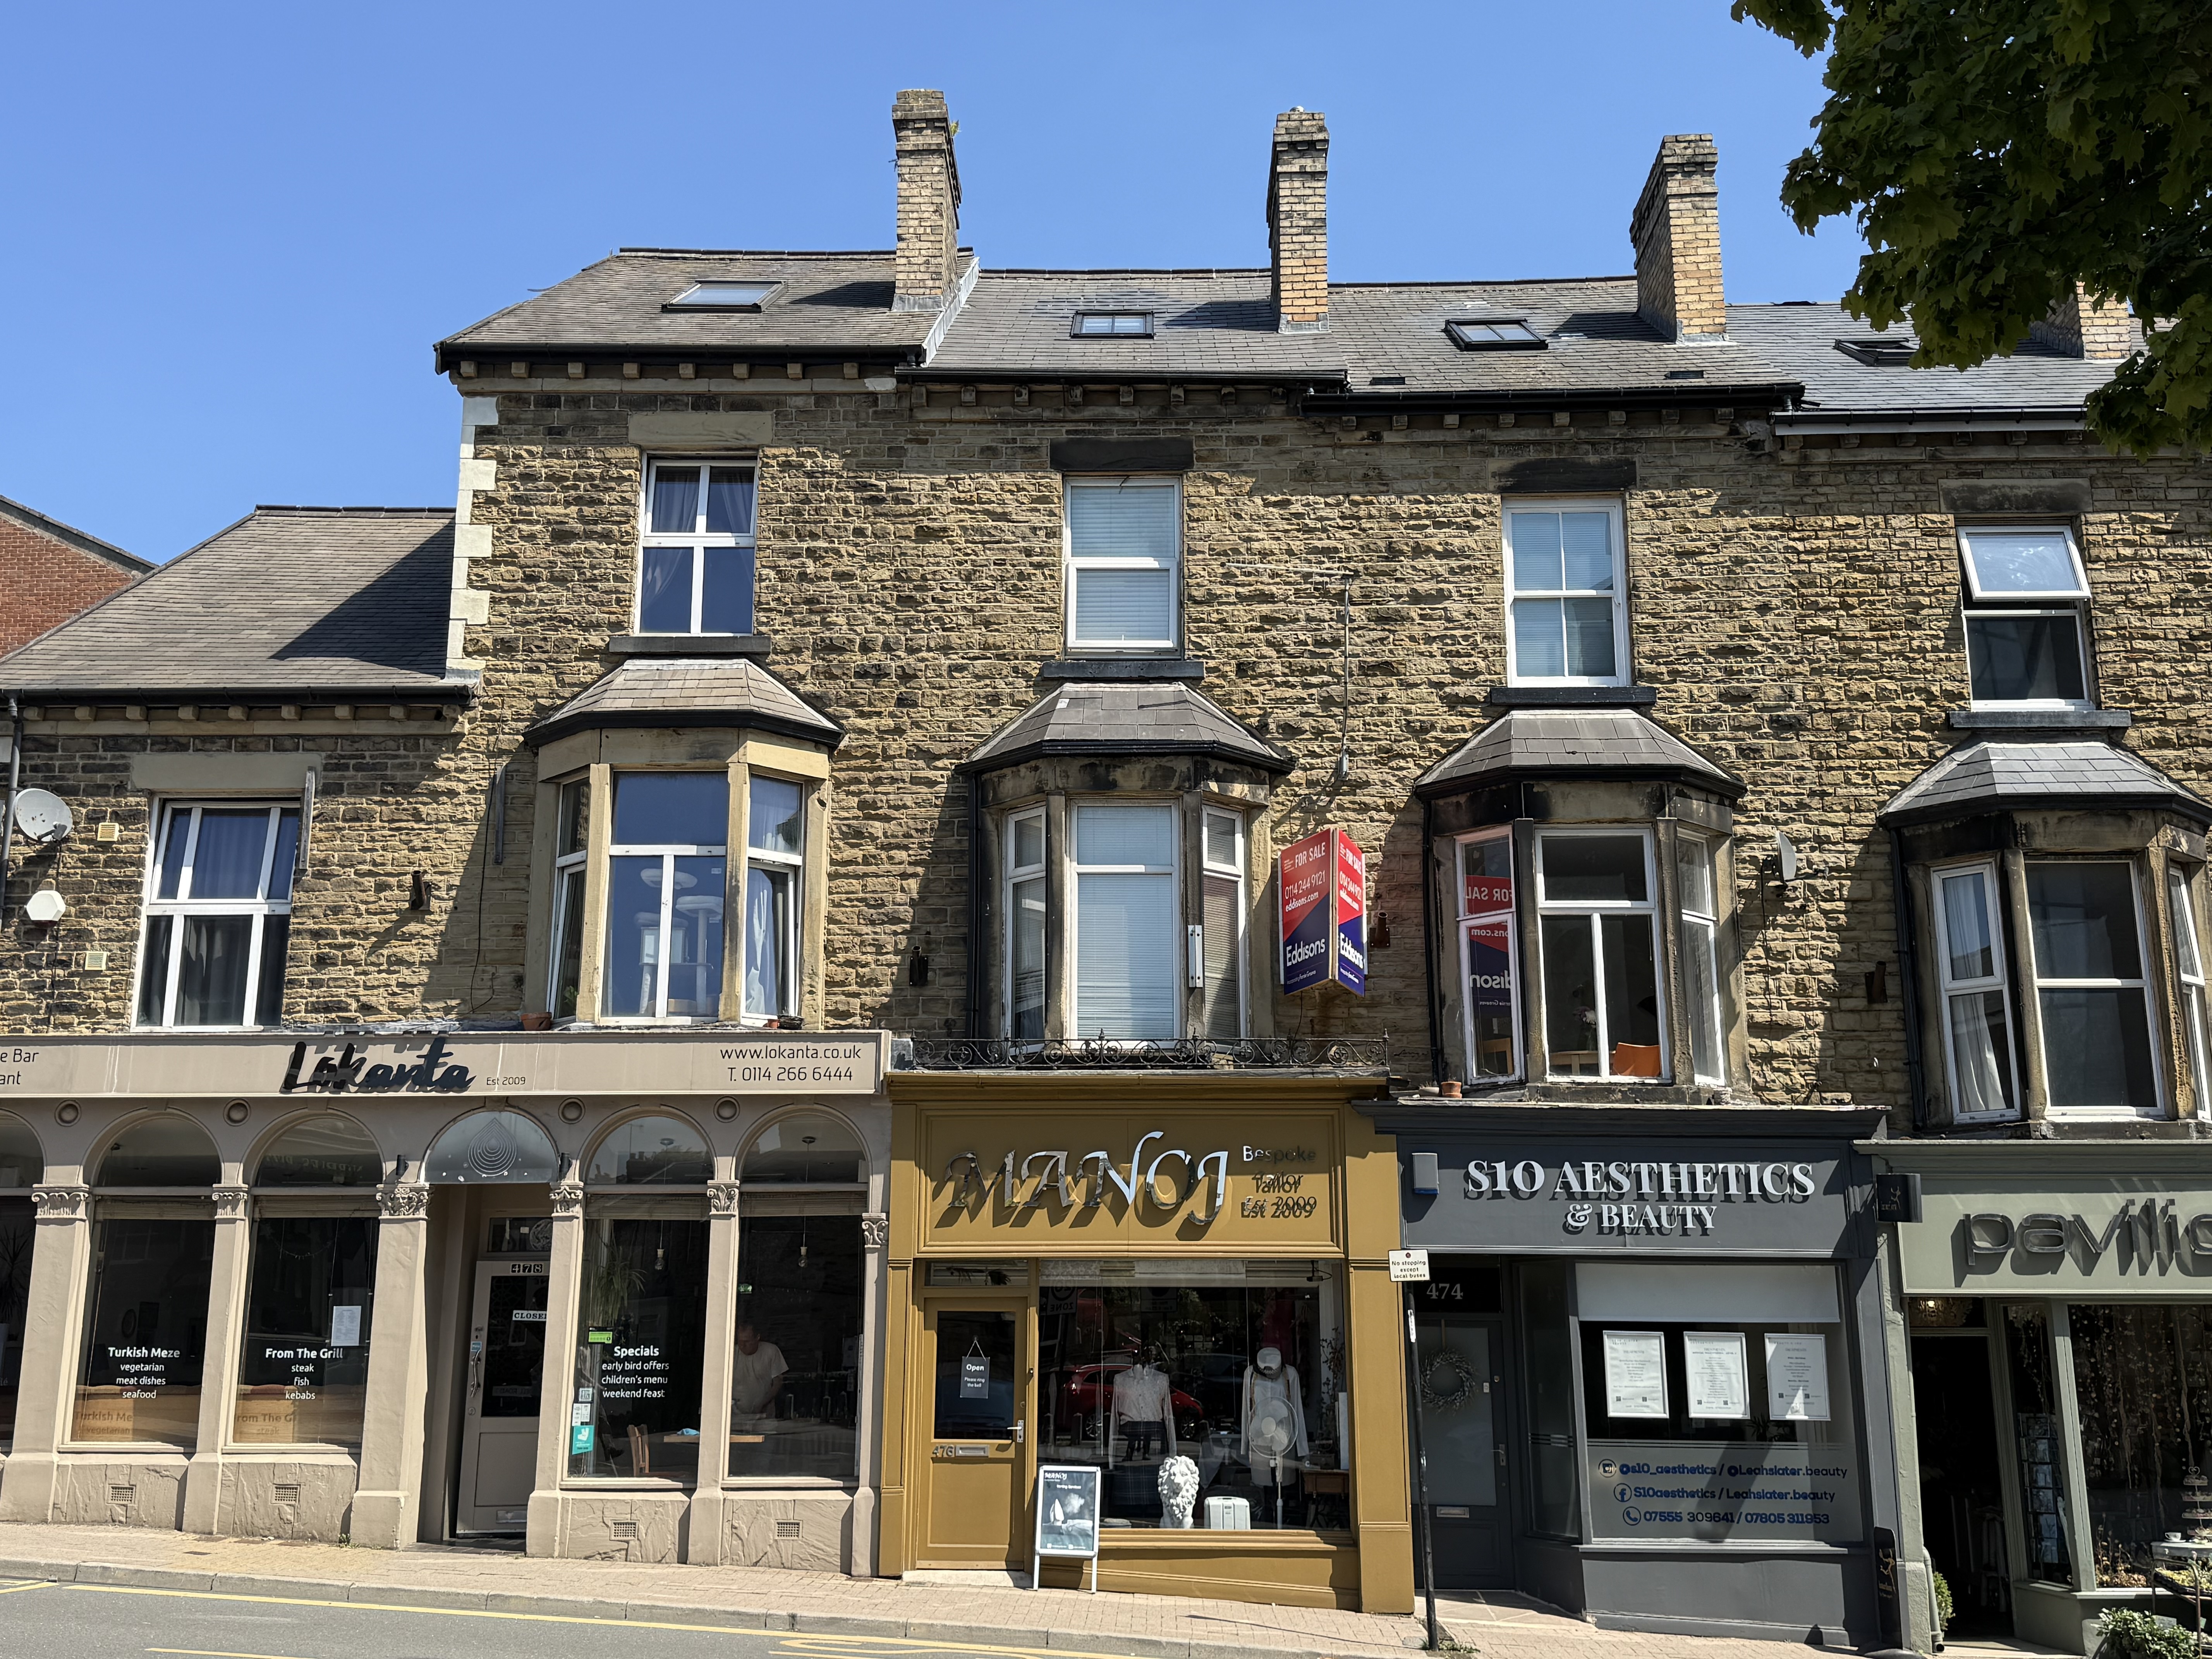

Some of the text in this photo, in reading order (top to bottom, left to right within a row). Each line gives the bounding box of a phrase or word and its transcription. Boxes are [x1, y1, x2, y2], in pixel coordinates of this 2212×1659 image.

[1295, 851, 1307, 868] FOR
[1309, 842, 1326, 861] SALE
[1285, 870, 1326, 899] 0114 244 9121
[1286, 891, 1319, 912] eddisons.com
[1286, 938, 1325, 966] Eddisons
[1340, 932, 1364, 969] Eddisons
[13, 1049, 39, 1062] Bar
[720, 1045, 861, 1059] www.lokanta.co.uk
[282, 1037, 526, 1090] Lokanta Est 2009
[728, 1067, 853, 1082] T. 0114 266 6444
[1243, 1145, 1316, 1164] Bespoke
[944, 1131, 1229, 1225] MANOJ
[1467, 1160, 1815, 1195] S10 AESTHETICS
[1271, 1196, 1317, 1217] 2009
[1567, 1204, 1717, 1228] & BEAUTY
[512, 1264, 542, 1273] 478
[1427, 1283, 1463, 1299] 474
[108, 1346, 180, 1358] Turkish Meze
[265, 1348, 343, 1358] From The Grill
[614, 1345, 659, 1358] Specials
[120, 1363, 164, 1372] vegetarian
[291, 1364, 314, 1372] steak
[602, 1360, 669, 1371] early bird offers
[966, 1364, 984, 1372] Open
[116, 1376, 166, 1385] meat dishes
[294, 1377, 309, 1386] fish
[601, 1375, 642, 1384] children's
[122, 1389, 156, 1398] seafood
[285, 1391, 316, 1400] kebabs
[603, 1389, 665, 1398] weekend feast
[932, 1445, 955, 1457] 476
[1633, 1487, 1716, 1499] S10aesthetics
[1726, 1488, 1835, 1503] Leahslater.beauty
[1644, 1511, 1683, 1522] 07555
[1687, 1511, 1735, 1523] 309641
[1745, 1513, 1785, 1524] 07805
[1786, 1513, 1830, 1524] 311953
